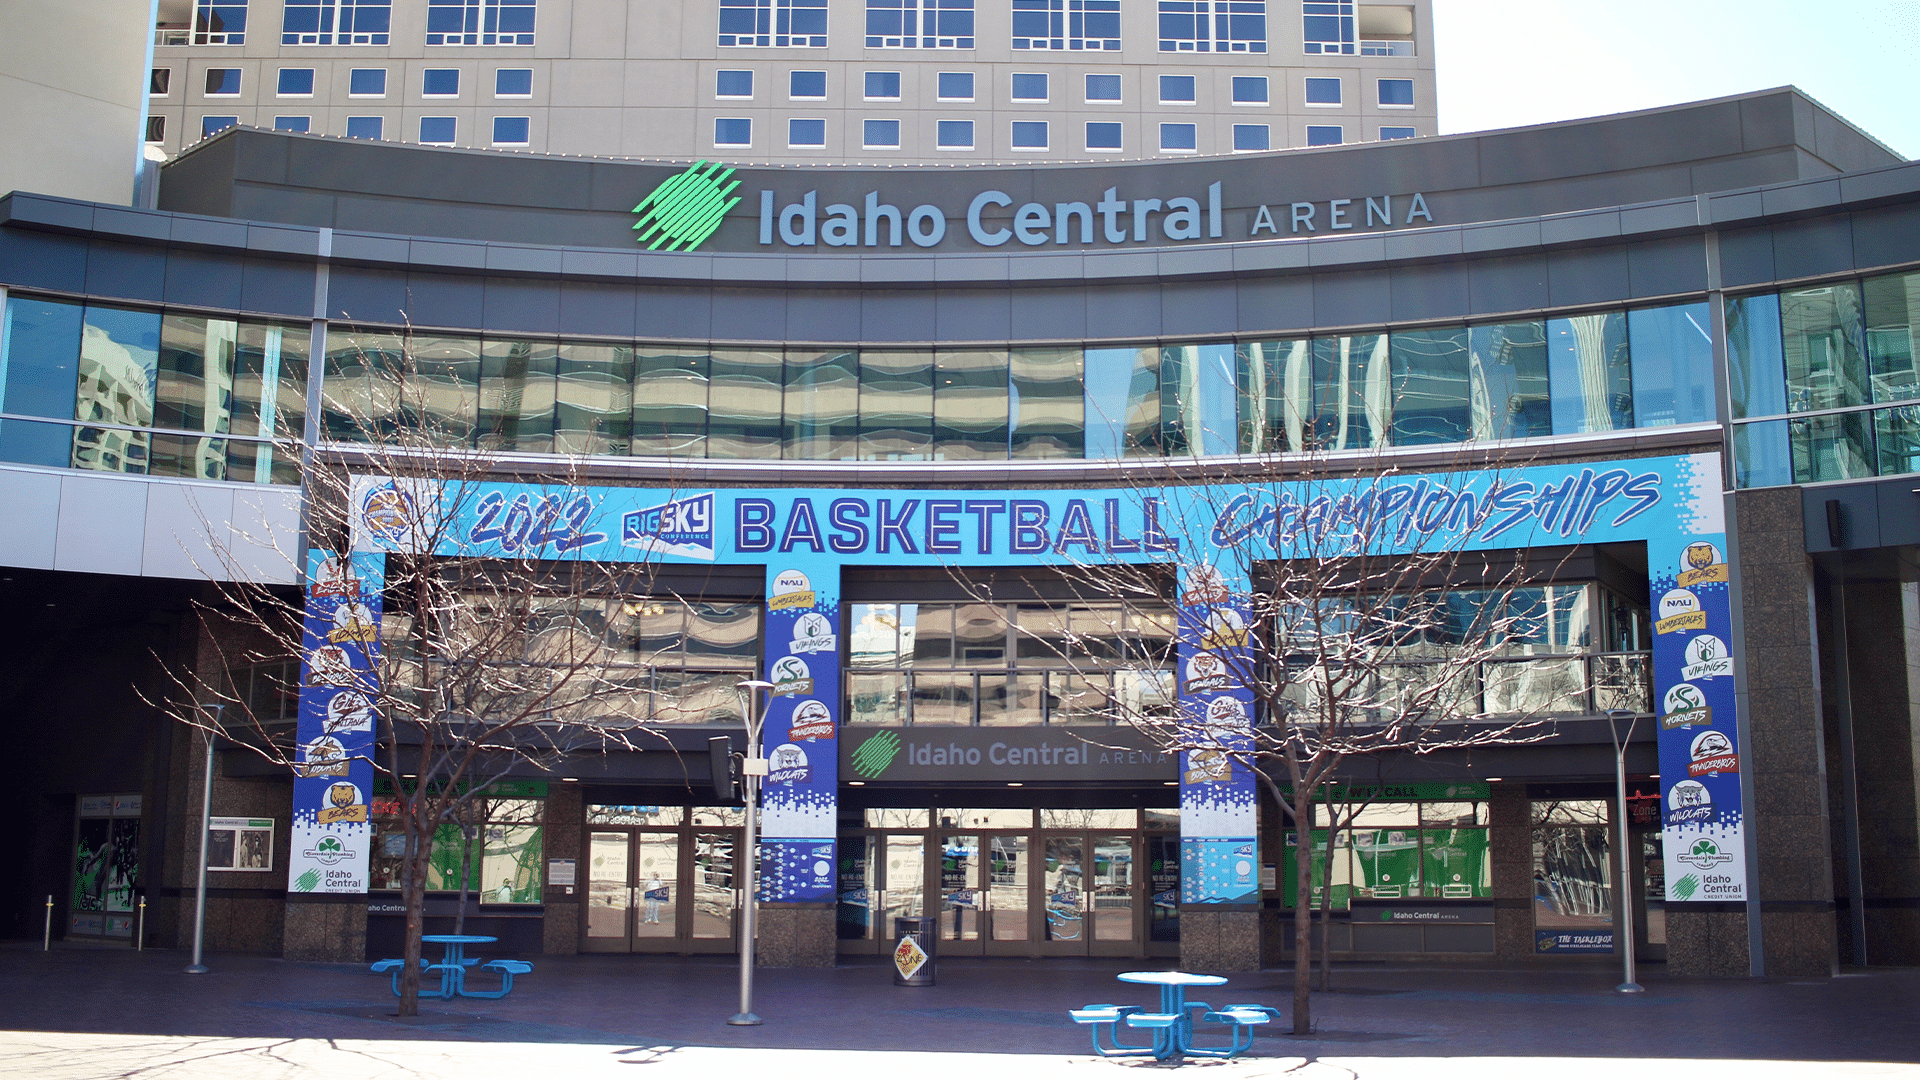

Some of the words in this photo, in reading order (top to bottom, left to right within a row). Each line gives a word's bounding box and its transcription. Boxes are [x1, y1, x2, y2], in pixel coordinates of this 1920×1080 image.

[760, 189, 946, 247] Idaho
[966, 181, 1223, 246] Central
[1251, 192, 1434, 235] ARENA
[626, 511, 660, 533] BIG
[660, 498, 710, 533] SKY
[1209, 468, 1663, 551] CHAMPIONSHIPS
[469, 489, 609, 553] 2022
[734, 497, 1180, 555] BASKETBALL
[1687, 568, 1719, 582] BEARS
[1667, 599, 1692, 607] NAU
[796, 636, 832, 650] VIKINGS
[1688, 660, 1729, 677] VIKINGS
[1665, 709, 1706, 725] HORNETS
[908, 742, 982, 766] Idaho
[988, 741, 1088, 766] Central
[1099, 752, 1167, 765] ARENA
[1689, 757, 1736, 774] THUNDERBIRDS
[769, 768, 809, 782] WILDCATS
[1384, 786, 1418, 798] CALL
[327, 808, 359, 820] BEARS
[1632, 803, 1657, 816] Zone
[1669, 807, 1712, 823] WILDCATS
[326, 870, 352, 878] Idaho
[1703, 874, 1731, 884] Idaho
[325, 878, 361, 887] Central
[1703, 883, 1742, 893] Central
[1558, 934, 1571, 943] THE
